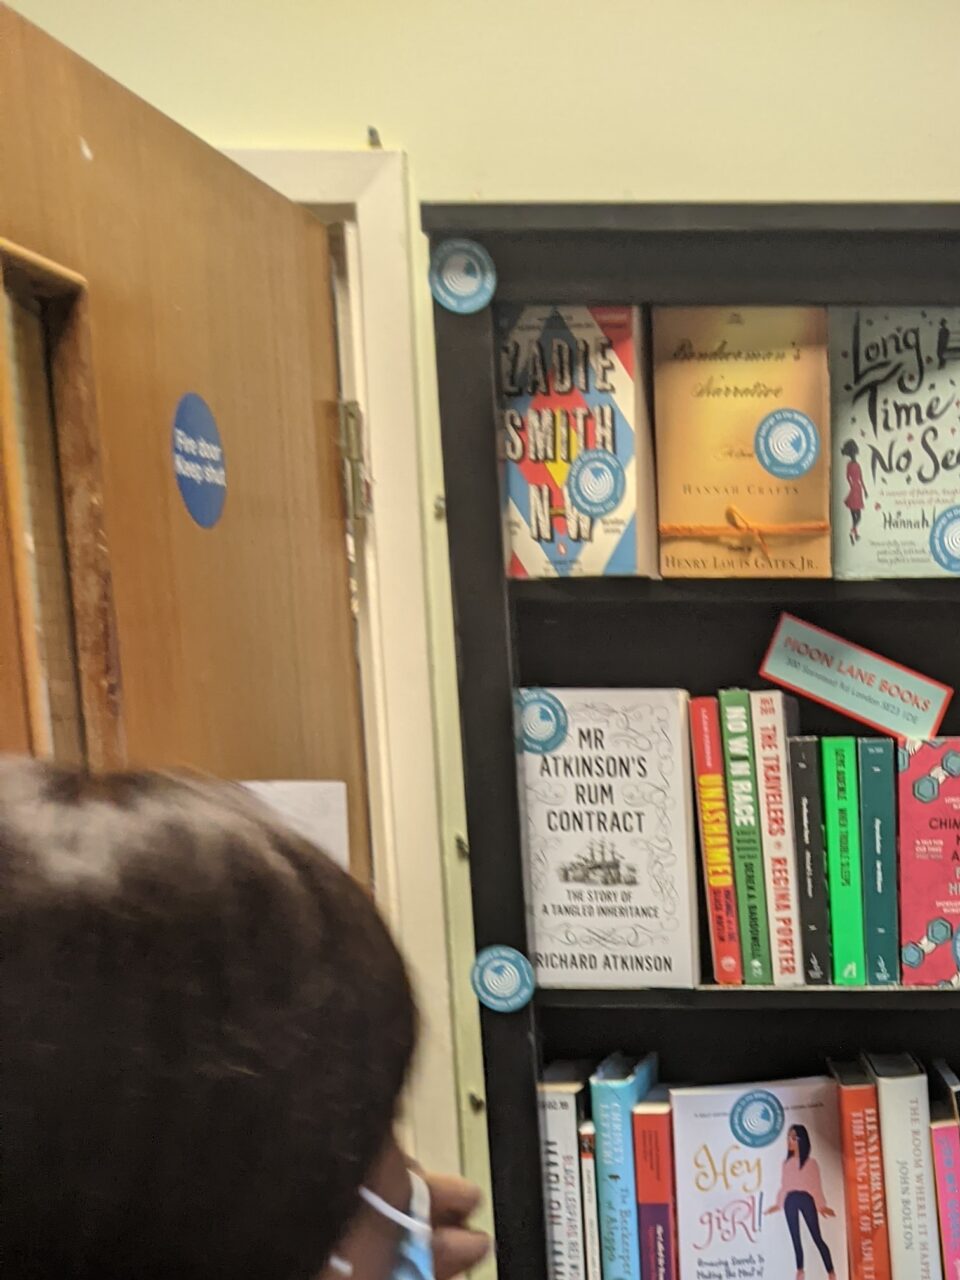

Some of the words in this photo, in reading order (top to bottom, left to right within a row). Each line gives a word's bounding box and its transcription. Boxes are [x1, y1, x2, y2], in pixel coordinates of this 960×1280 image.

[502, 338, 616, 396] ZADIE
[853, 310, 924, 393] Long
[853, 363, 957, 437] Time
[504, 404, 617, 463] SMITH
[866, 440, 912, 486] No
[683, 484, 739, 495] HANNAH
[747, 484, 799, 494] CRAFTS
[882, 508, 930, 530] Hannah
[665, 555, 708, 571] HENRY
[713, 556, 750, 571] LOUIS
[783, 636, 835, 668] MOON
[837, 658, 876, 687] LANE
[879, 679, 931, 712] BOOKS
[578, 728, 605, 750] MR
[725, 706, 748, 733] NO
[760, 726, 778, 750] THE
[540, 754, 648, 778] ATKINSON'S
[575, 784, 614, 805] RUM
[732, 780, 756, 827] RACE
[762, 755, 786, 837] TRAVELERS
[547, 811, 646, 833] CONTRACT
[698, 774, 734, 888] UNASHAMED
[567, 889, 587, 902] THE
[588, 889, 619, 902] STORY
[622, 889, 633, 902] OF
[771, 857, 791, 912] REGINA
[541, 905, 549, 915] A
[551, 905, 595, 917] TANGLED
[597, 905, 660, 919] INHERITANCE
[536, 952, 598, 970] RICHARD
[602, 953, 673, 972] ATKINSON
[775, 917, 796, 975] PORTER
[851, 1111, 863, 1137] THE
[864, 1107, 879, 1153] ELENA
[910, 1097, 920, 1125] THE
[693, 1144, 762, 1192] Hey
[854, 1141, 868, 1182] LYING
[912, 1129, 923, 1169] ROOM
[562, 1154, 573, 1186] BLACK
[896, 1160, 909, 1197] JOHN
[857, 1183, 870, 1216] LIFE
[869, 1155, 885, 1228] FERRANTE
[914, 1172, 926, 1220] WHERE
[565, 1187, 577, 1238] LEOPARD
[860, 1219, 871, 1232] OF
[901, 1199, 914, 1251] BOLTON
[918, 1224, 928, 1237] IT
[567, 1240, 579, 1262] RED
[607, 1215, 618, 1262] Aleppo
[619, 1208, 632, 1276] Beekeeper
